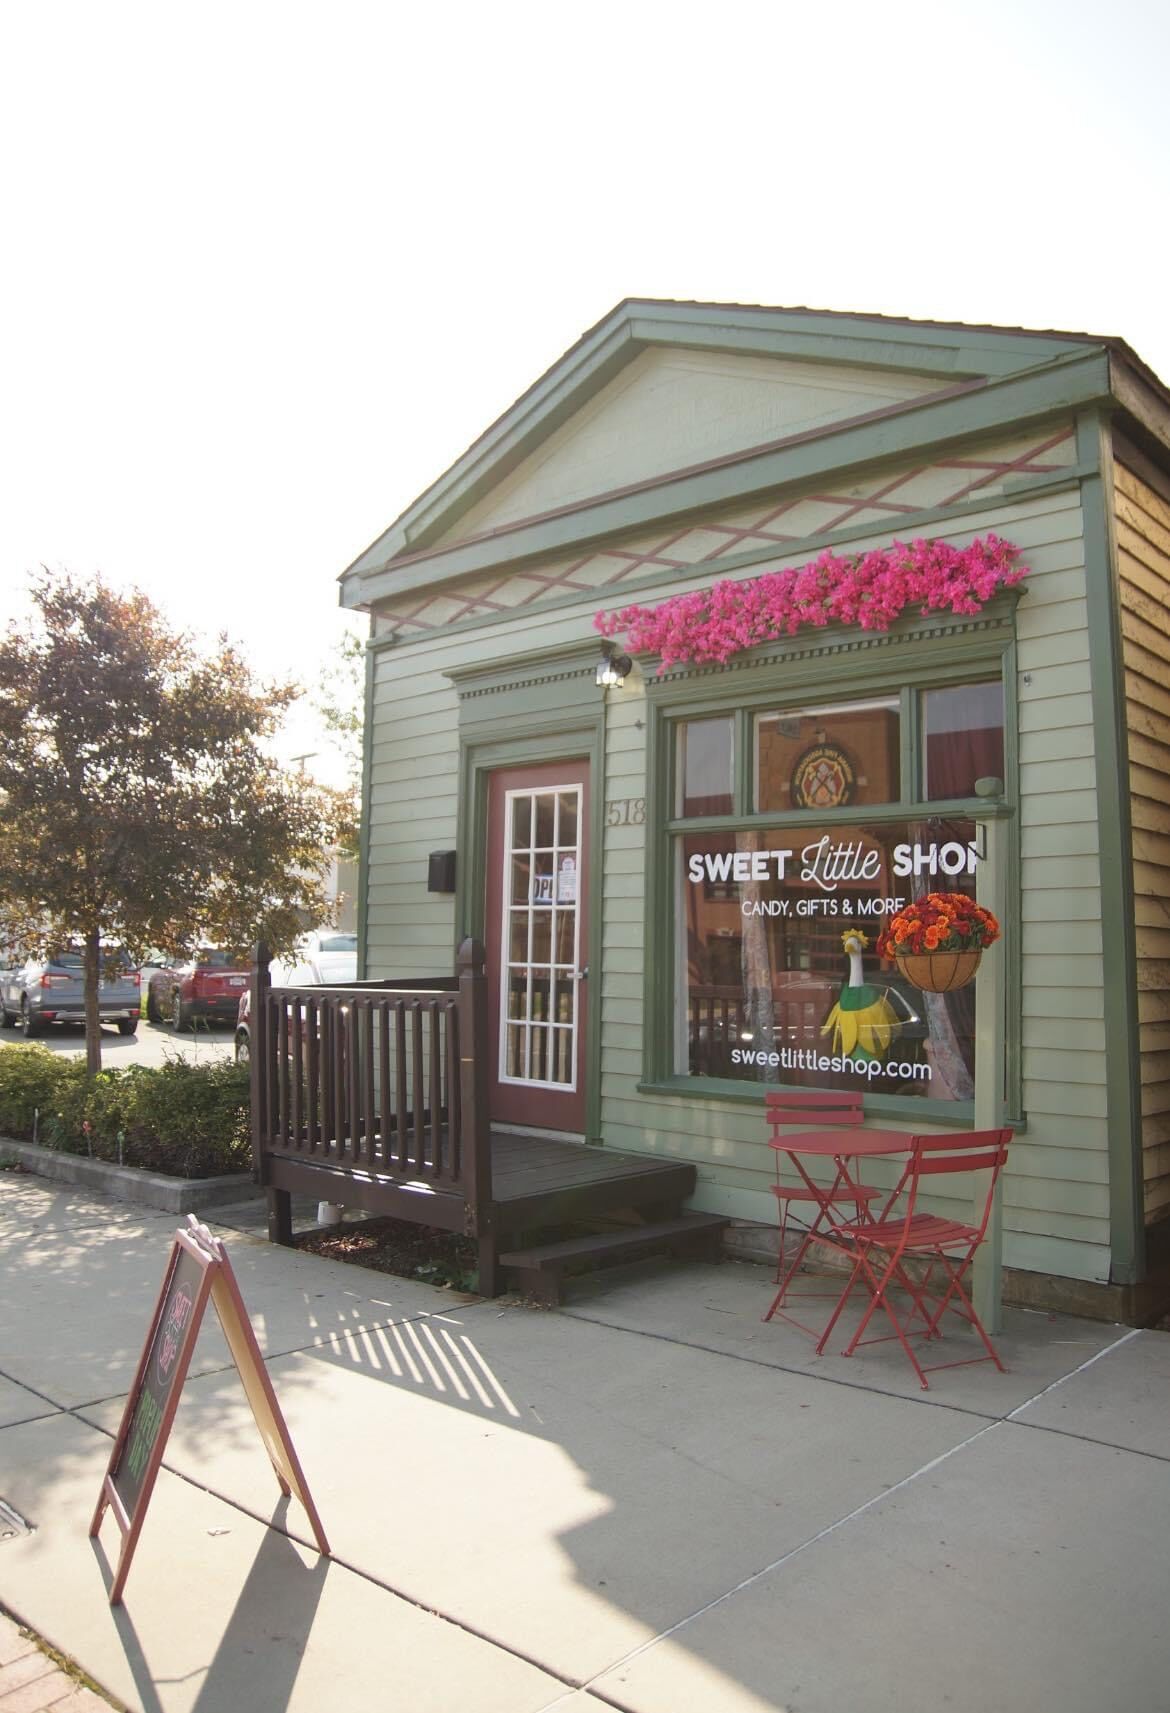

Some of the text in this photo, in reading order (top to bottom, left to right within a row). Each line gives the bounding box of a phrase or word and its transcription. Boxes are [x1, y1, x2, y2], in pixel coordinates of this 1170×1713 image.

[607, 799, 646, 826] 518
[688, 850, 792, 883] SWEET
[800, 834, 882, 892] Little
[742, 900, 793, 918] CANDY,
[797, 899, 838, 916] GIFTS
[842, 899, 854, 915] &
[731, 1048, 932, 1081] sweetlittleshop.com
